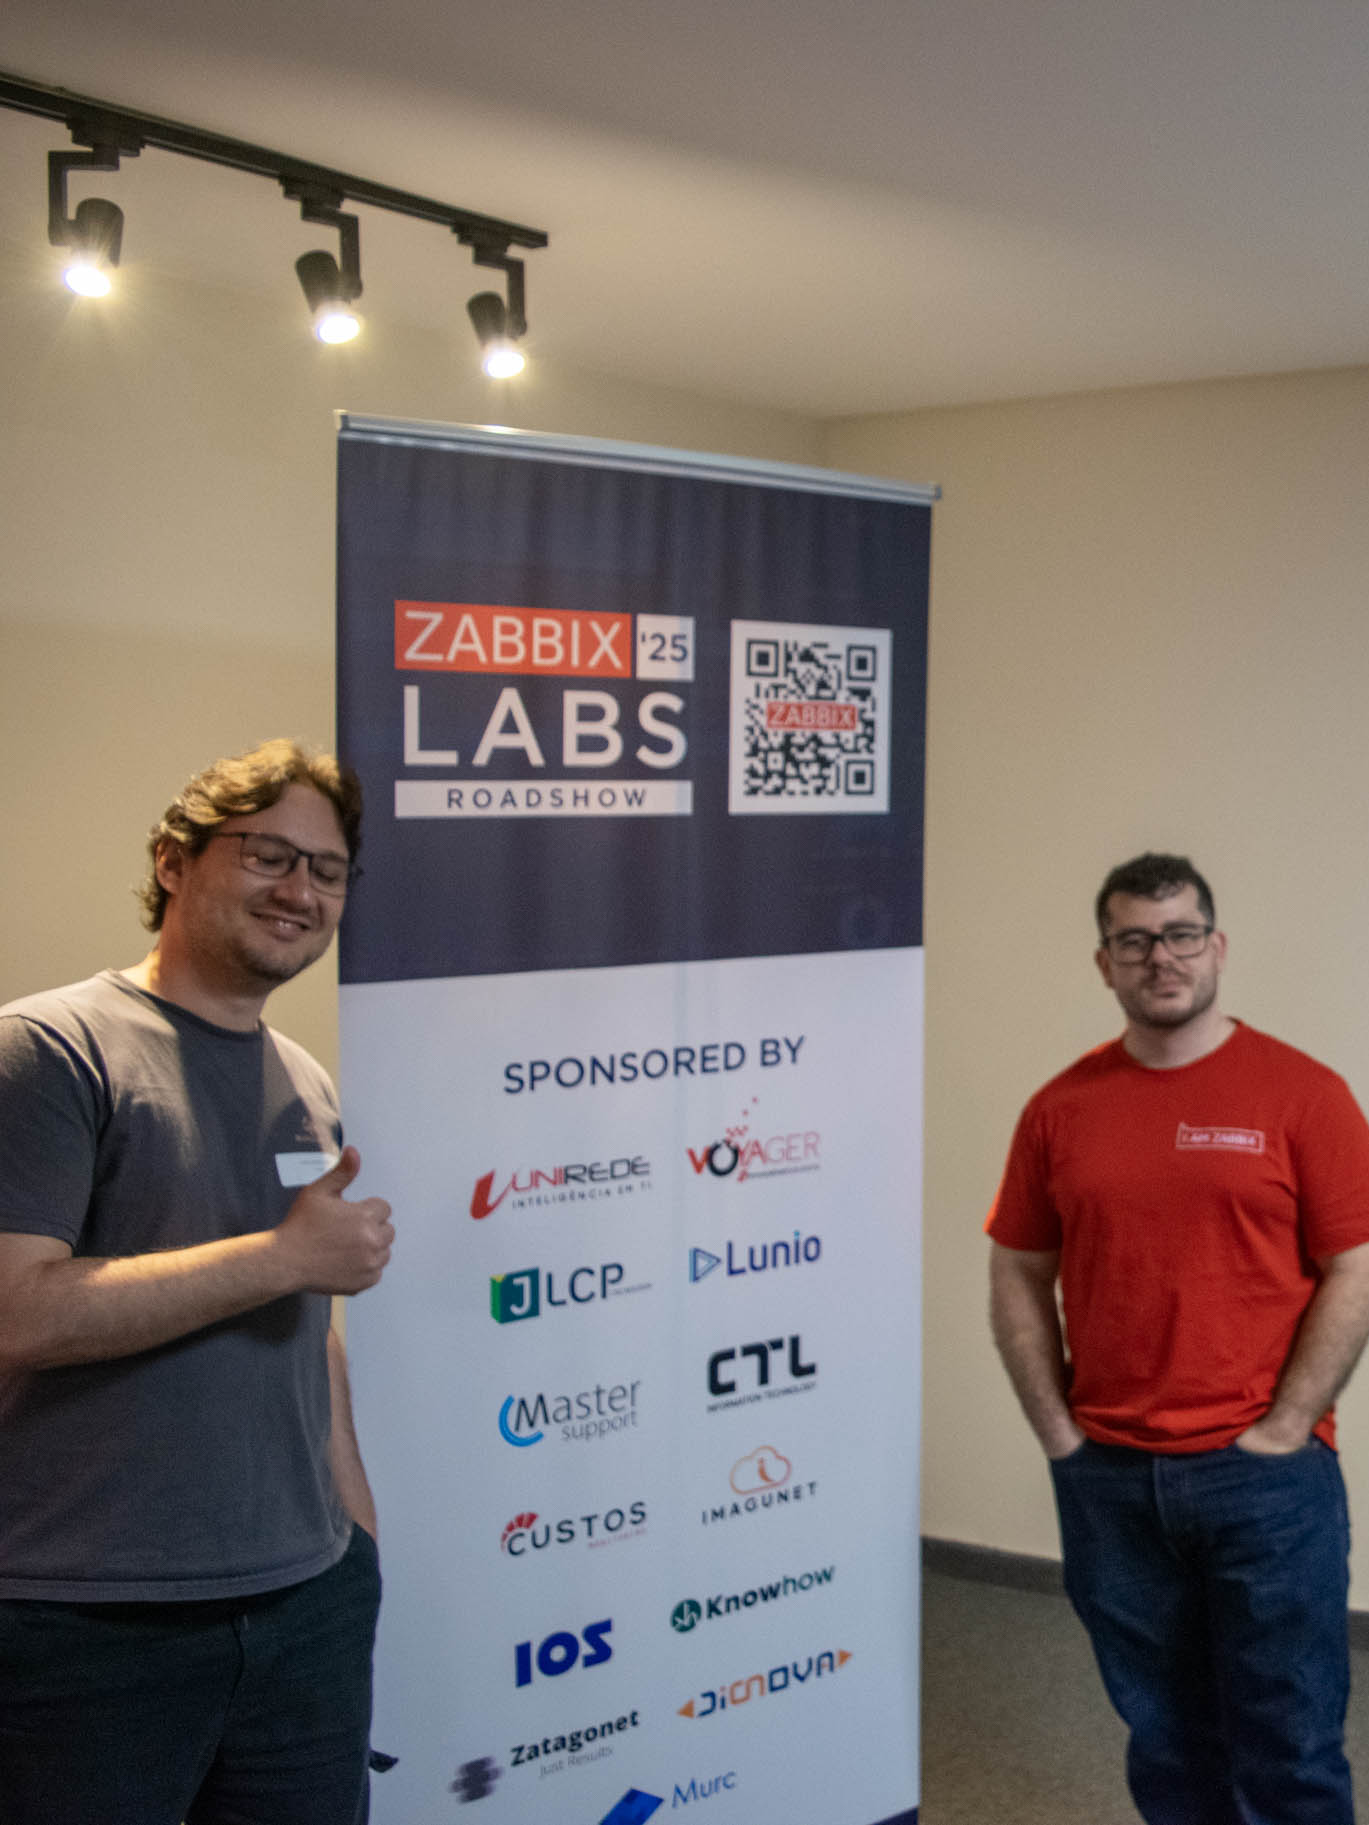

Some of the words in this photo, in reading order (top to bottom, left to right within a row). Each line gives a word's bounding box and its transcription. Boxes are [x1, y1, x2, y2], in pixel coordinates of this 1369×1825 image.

[404, 609, 623, 669] ZABBIX
[640, 633, 689, 664] '25
[403, 685, 689, 769] LABS
[770, 706, 856, 729] ZABBIX
[447, 788, 648, 810] ROADSHOW
[503, 1042, 746, 1094] SPONSORED
[760, 1035, 805, 1067] BY
[511, 1155, 650, 1192] UNIREDE
[686, 1130, 820, 1180] VOYAGER
[726, 1230, 822, 1277] Lunio
[708, 1335, 817, 1396] CTL
[514, 1380, 641, 1432] Master
[561, 1409, 638, 1442] support
[507, 1501, 646, 1556] CUSTOS
[702, 1481, 818, 1525] IMAGUNET
[705, 1566, 836, 1620] Knowhow
[515, 1618, 613, 1688] IOS
[510, 1710, 639, 1767] Zatagonet
[672, 1771, 737, 1809] Murc
